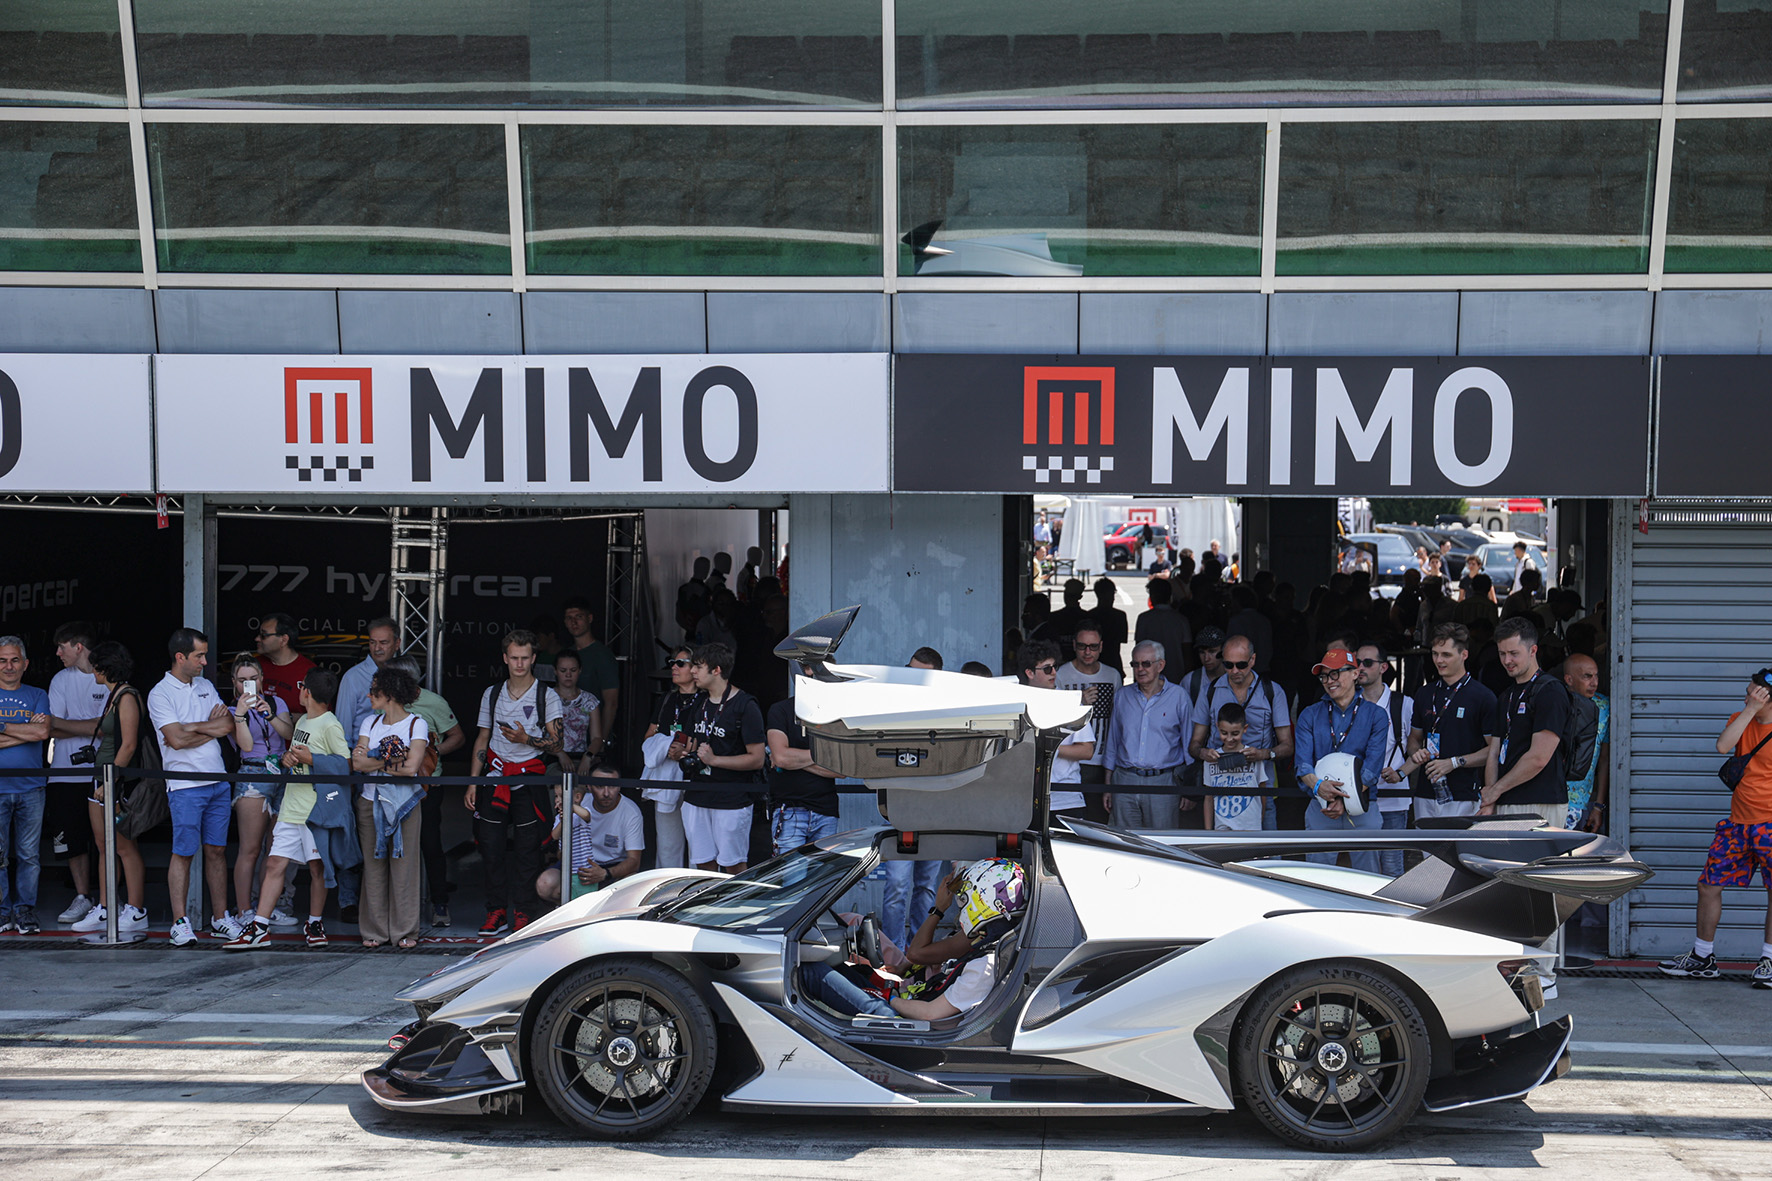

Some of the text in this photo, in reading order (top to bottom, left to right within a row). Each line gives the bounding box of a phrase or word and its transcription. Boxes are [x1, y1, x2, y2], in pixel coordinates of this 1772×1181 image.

[410, 365, 758, 483] MIMO
[1152, 366, 1514, 487] MIMO
[157, 496, 167, 516] 48
[1640, 500, 1649, 523] 46
[218, 564, 309, 592] 777
[0, 578, 79, 622] percar
[247, 616, 516, 635] OCIAL PEATION
[1358, 974, 1412, 1019] MICHELIN
